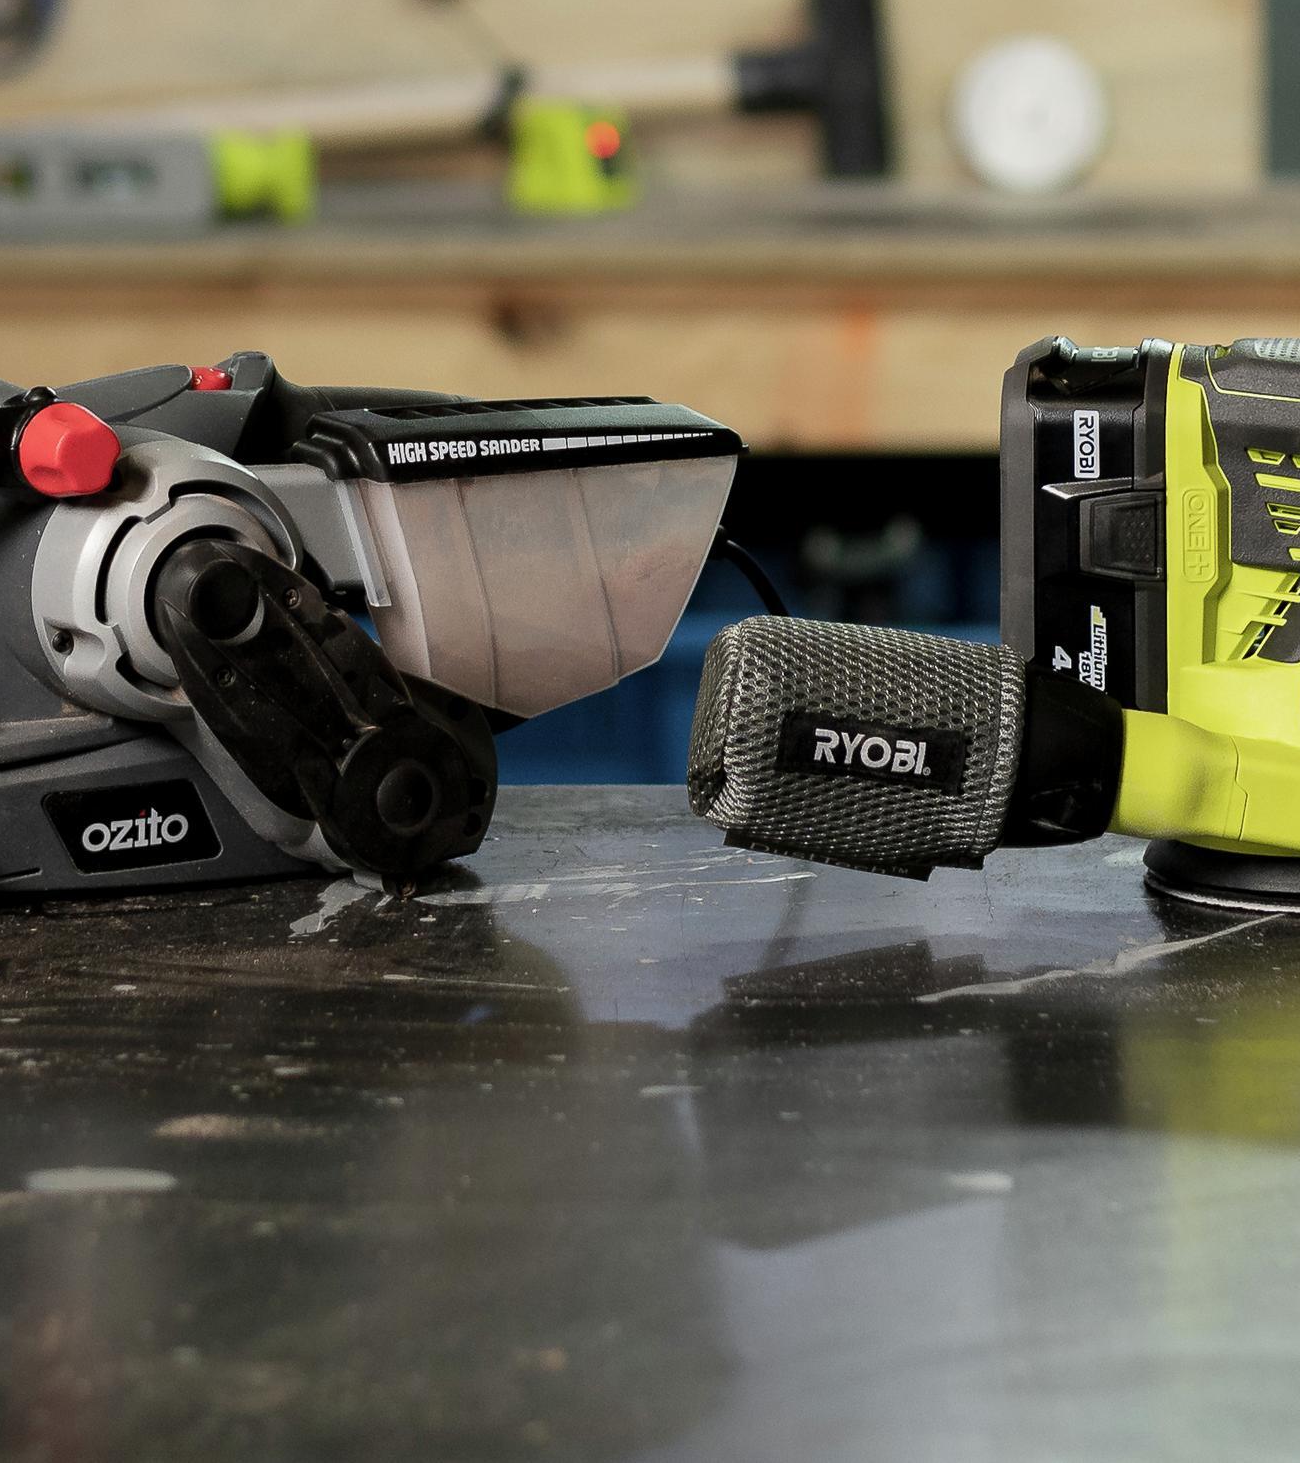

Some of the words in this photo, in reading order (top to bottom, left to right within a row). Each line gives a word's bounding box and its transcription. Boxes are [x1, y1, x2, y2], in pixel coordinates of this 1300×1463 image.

[387, 442, 427, 464] HIGH
[428, 440, 477, 461] SPEED
[479, 438, 540, 456] SANDER
[1078, 415, 1095, 474] RYOBI
[1092, 623, 1106, 689] Lithium
[813, 727, 927, 776] RYOBI
[82, 807, 189, 852] ozito
